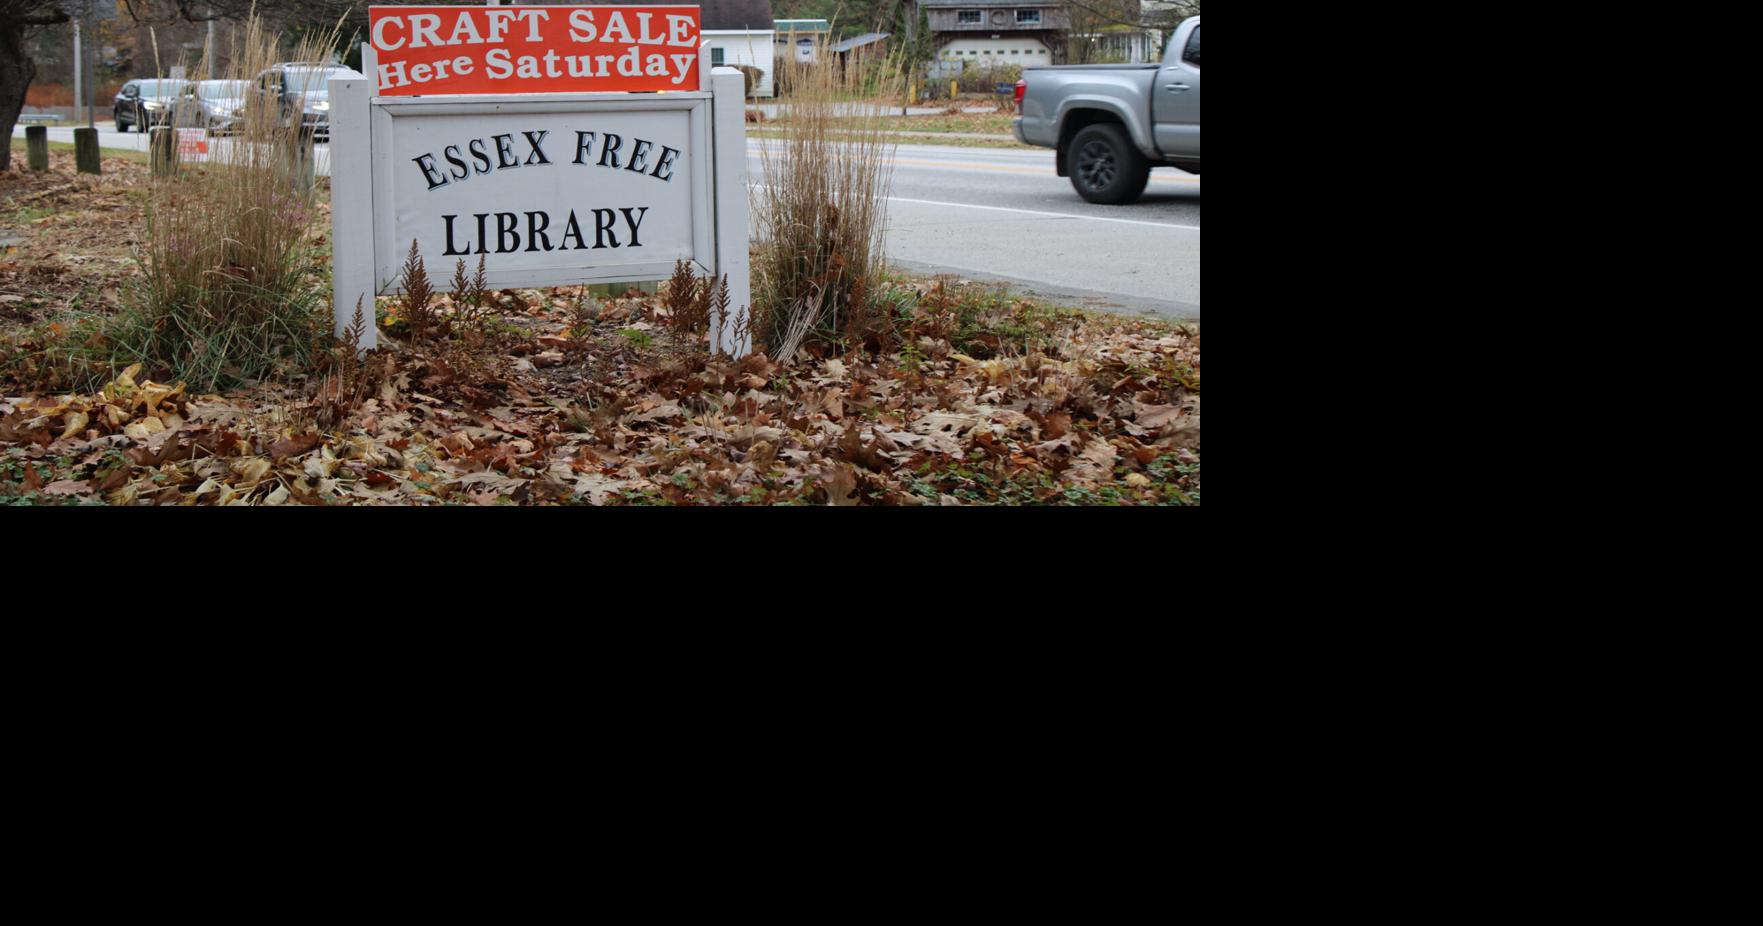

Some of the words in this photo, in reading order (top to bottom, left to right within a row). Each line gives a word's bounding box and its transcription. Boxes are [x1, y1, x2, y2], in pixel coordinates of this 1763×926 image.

[372, 9, 549, 51] CRAFT
[568, 9, 697, 48] SALE
[378, 55, 475, 90] Here
[484, 46, 697, 84] Saturday
[412, 130, 551, 191] ESSEX
[571, 130, 680, 182] FREE
[441, 206, 649, 256] LIBRARY
